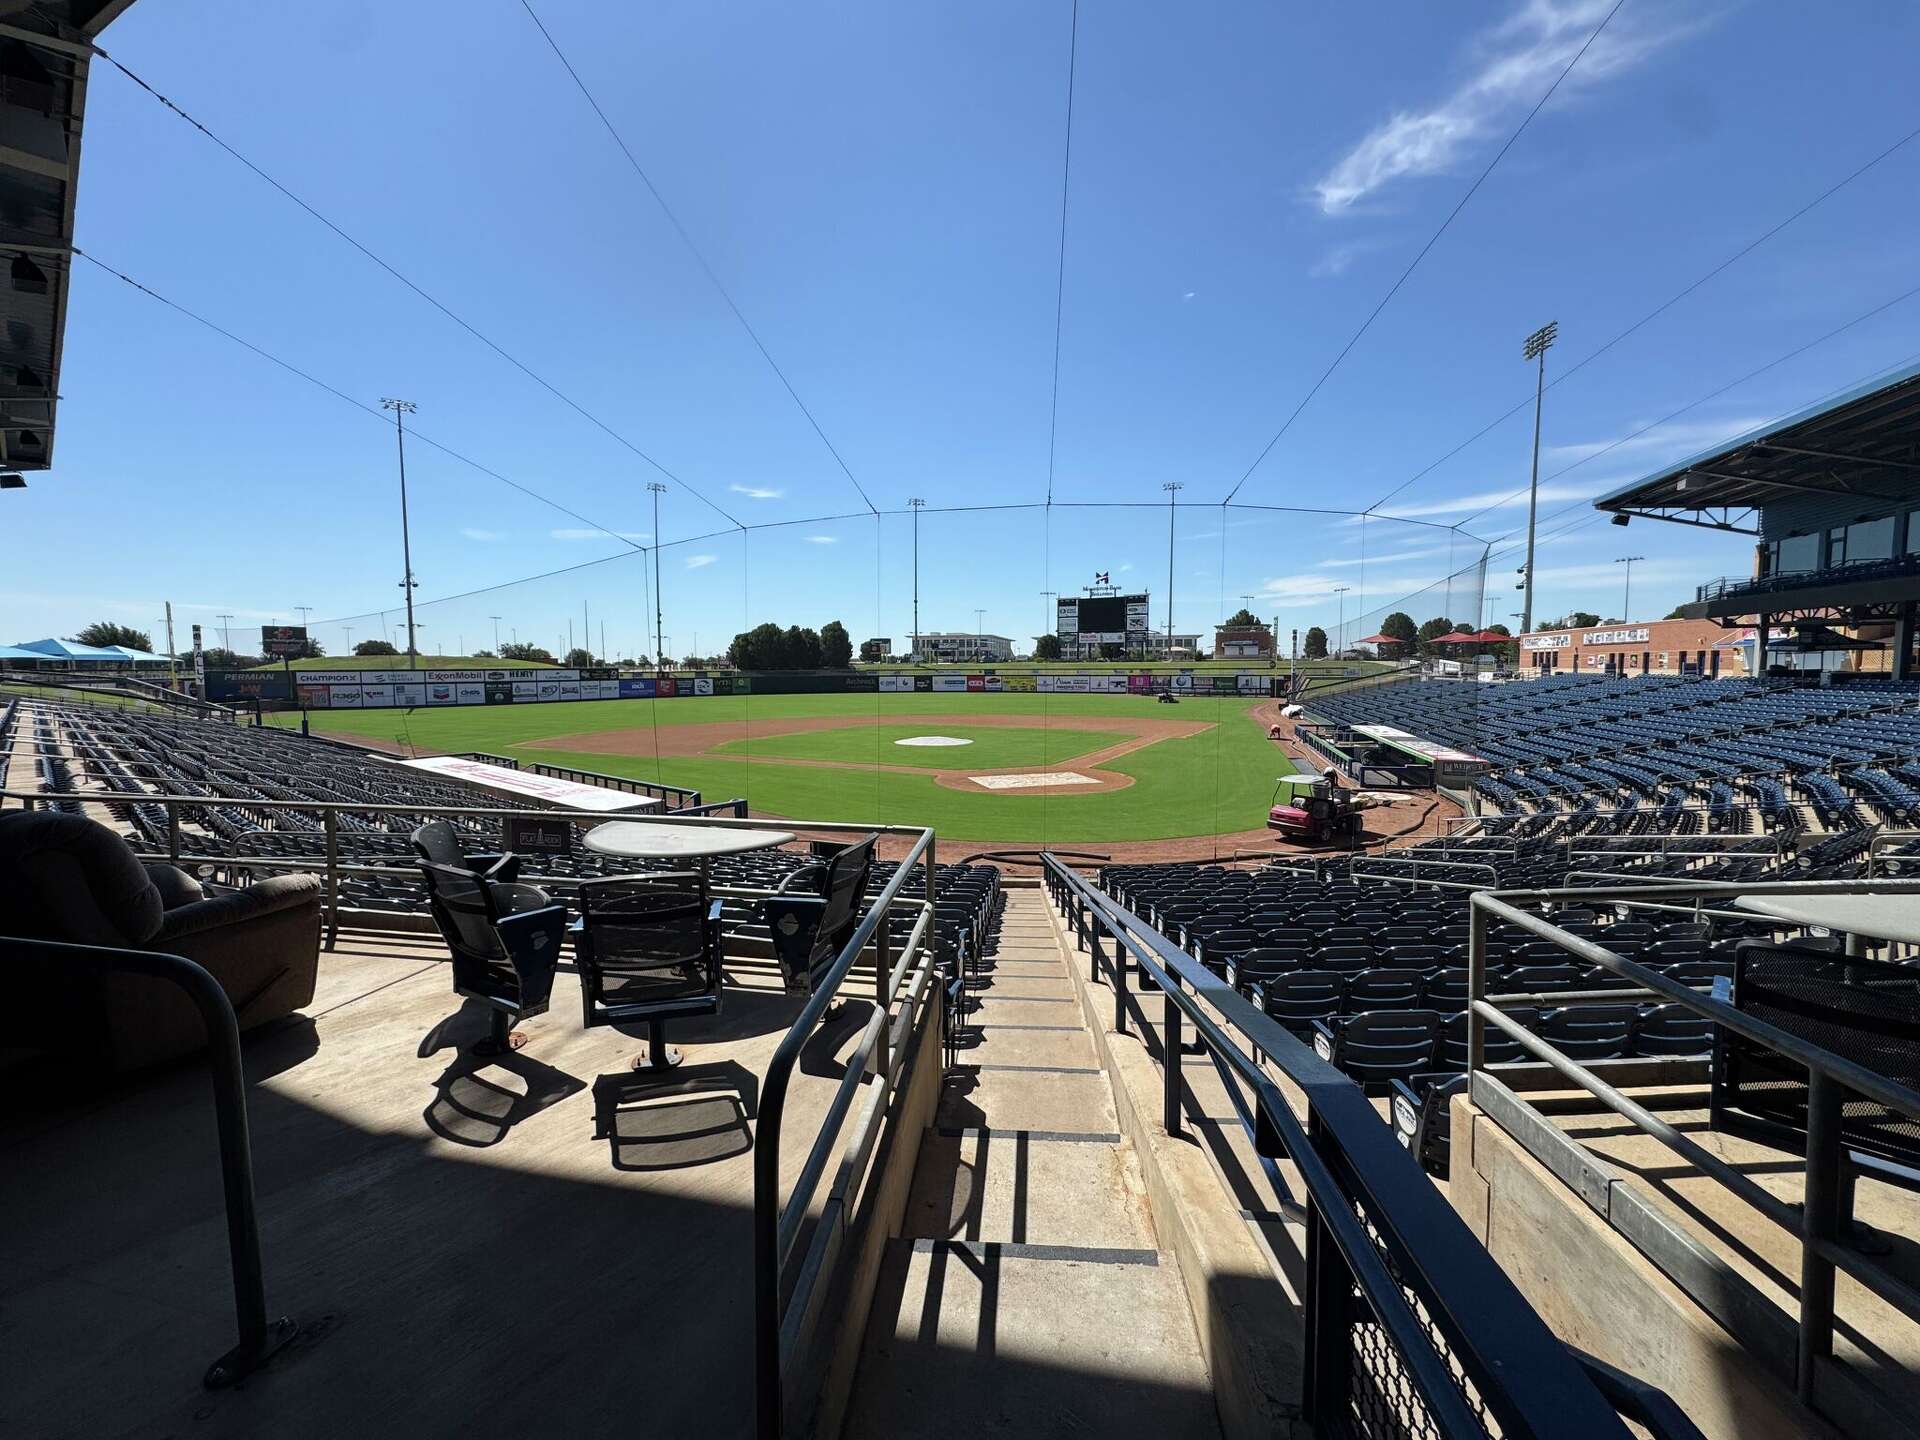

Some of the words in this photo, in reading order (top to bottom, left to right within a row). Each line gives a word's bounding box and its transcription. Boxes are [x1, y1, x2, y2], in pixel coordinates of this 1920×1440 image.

[224, 673, 274, 681] PERMIAN
[428, 671, 482, 681] ExxonMobil
[509, 670, 534, 678] HENRY
